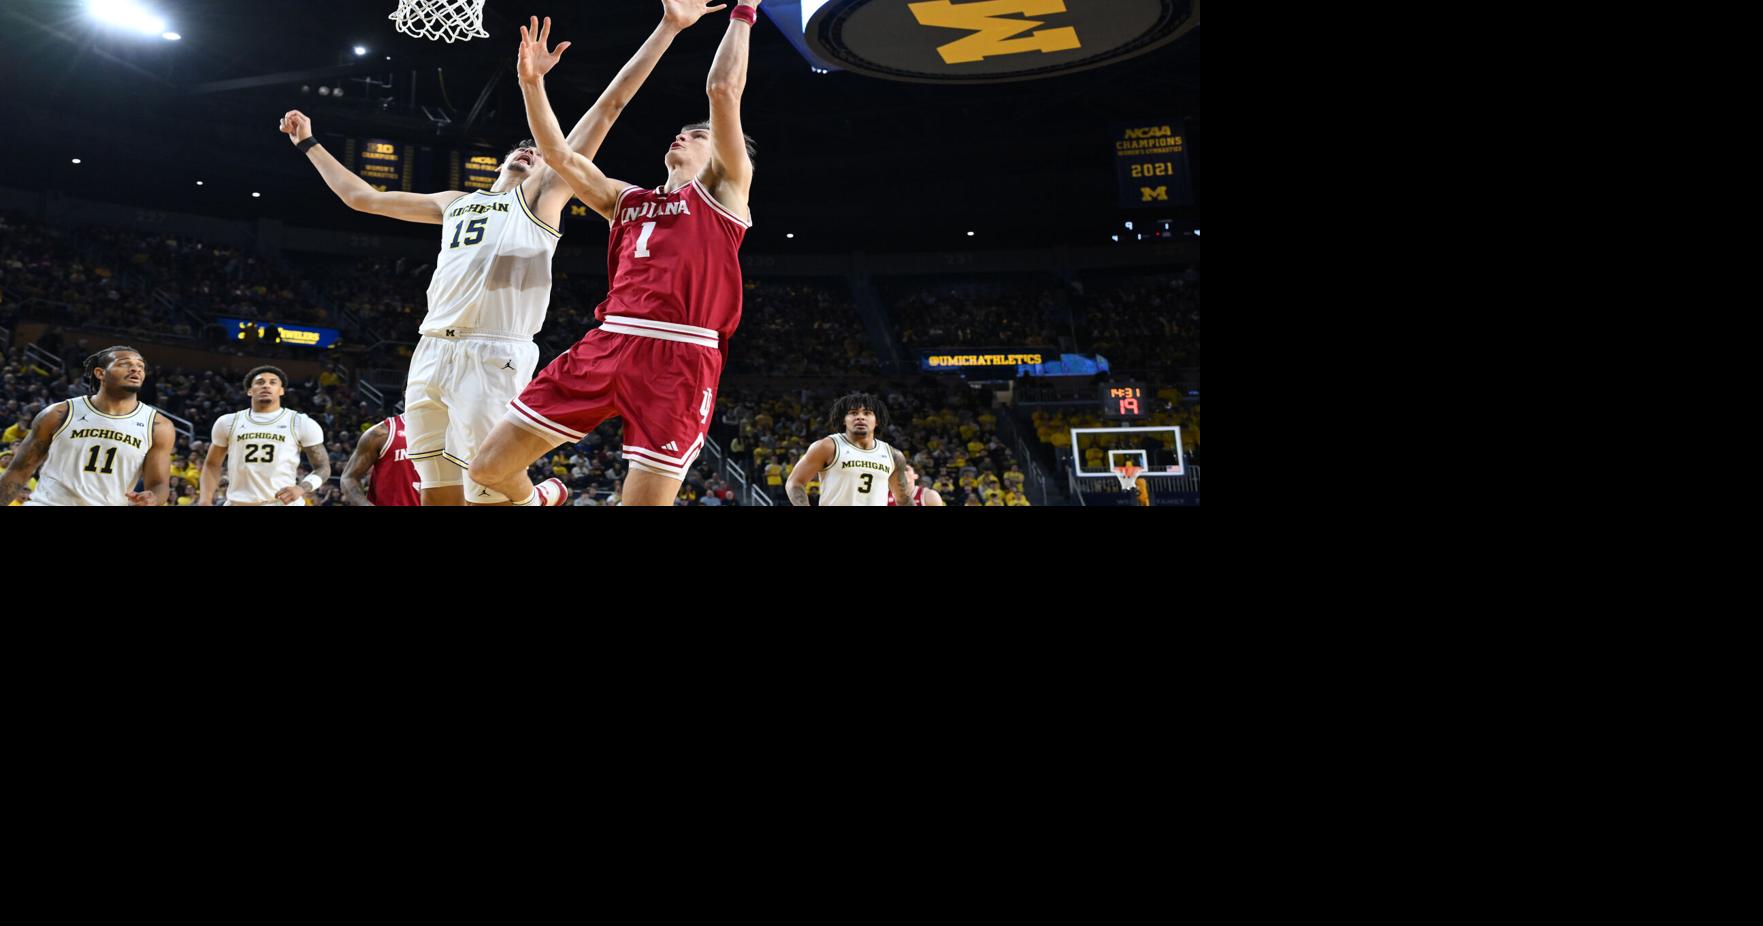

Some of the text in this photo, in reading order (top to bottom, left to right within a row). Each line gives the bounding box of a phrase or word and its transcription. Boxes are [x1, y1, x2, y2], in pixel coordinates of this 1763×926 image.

[907, 0, 1082, 64] M
[1125, 125, 1171, 139] NCAA
[1116, 136, 1183, 149] CHAMPIONS
[1131, 162, 1174, 177] 2021
[1140, 185, 1168, 202] M
[449, 217, 489, 249] 15
[634, 221, 656, 258] 1
[445, 329, 455, 337] M
[928, 354, 1042, 366] @UMICHATHLETICS
[1110, 387, 1141, 398] 14:31
[1119, 398, 1139, 415] 19
[70, 428, 142, 449] MICHIGAN
[236, 432, 286, 443] MICHIGAN
[84, 444, 118, 474] 11
[244, 443, 275, 463] 23
[841, 460, 891, 474] MICHIGAN
[858, 473, 874, 494] 3
